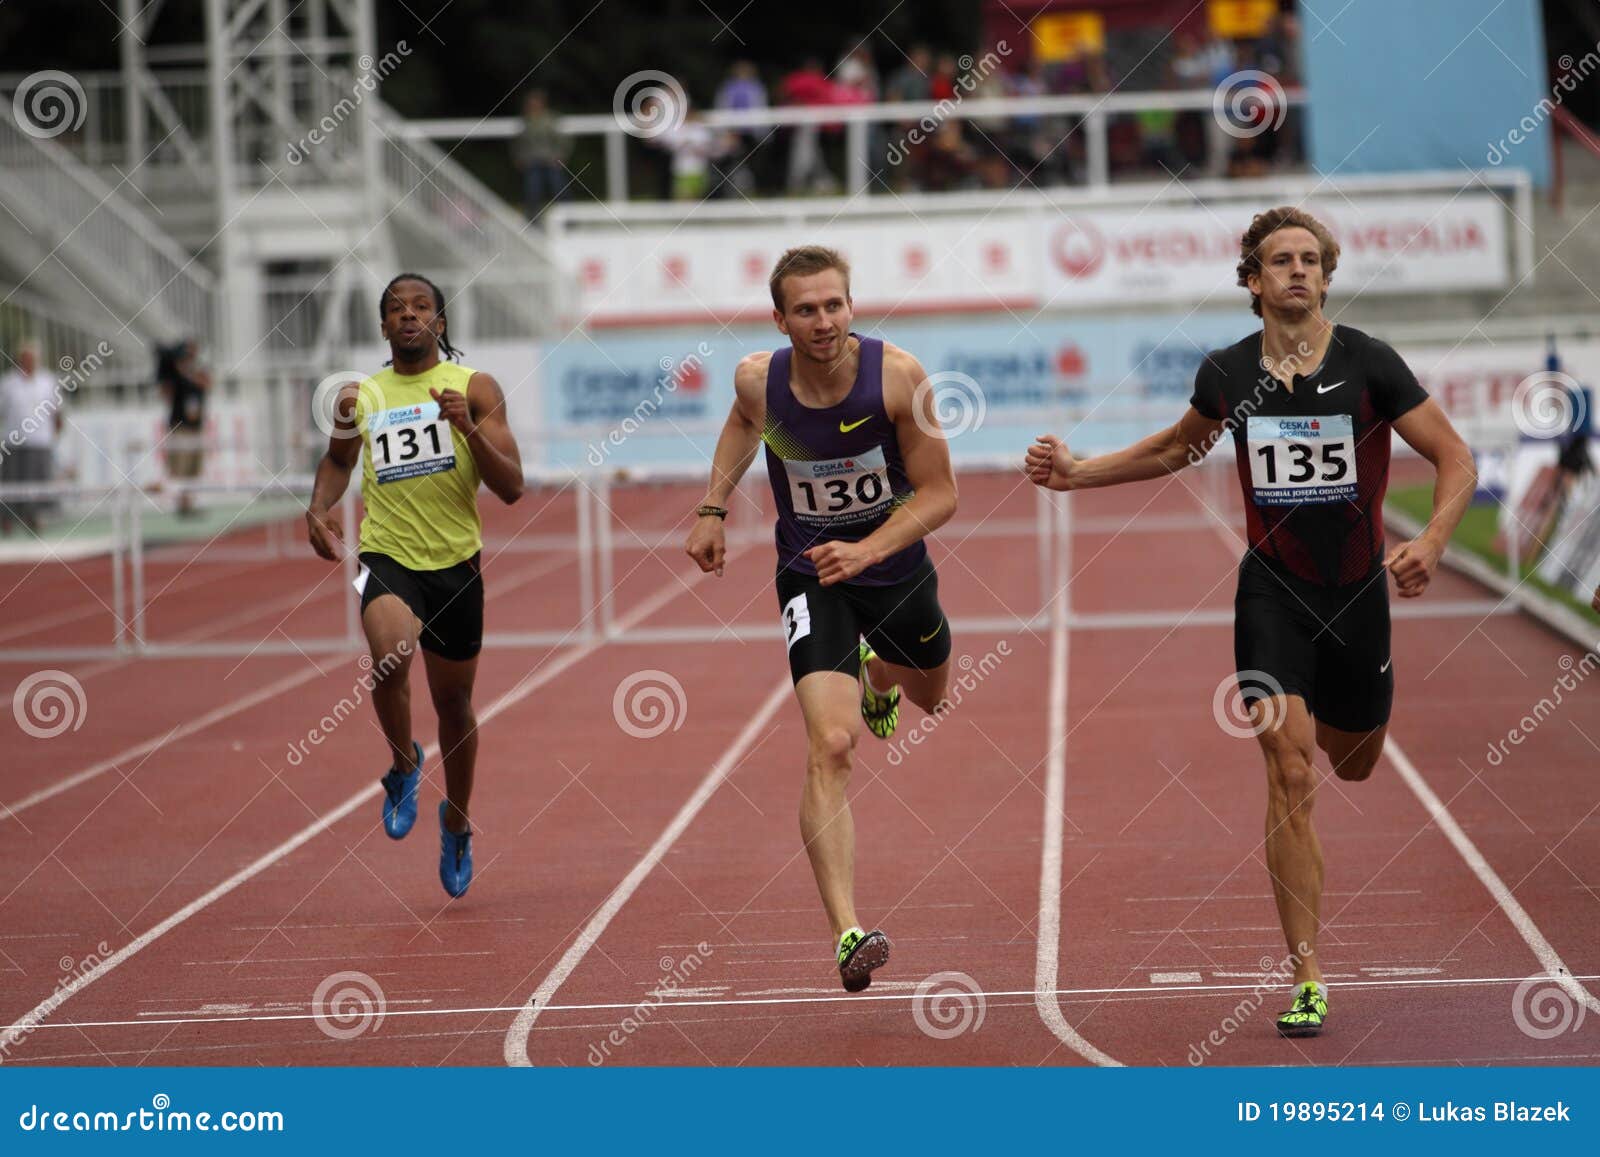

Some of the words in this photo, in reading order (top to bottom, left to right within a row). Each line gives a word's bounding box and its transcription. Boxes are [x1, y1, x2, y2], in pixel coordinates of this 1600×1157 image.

[376, 423, 442, 465] 131
[1257, 442, 1348, 484] 135
[797, 472, 883, 512] 130
[786, 606, 798, 643] 3
